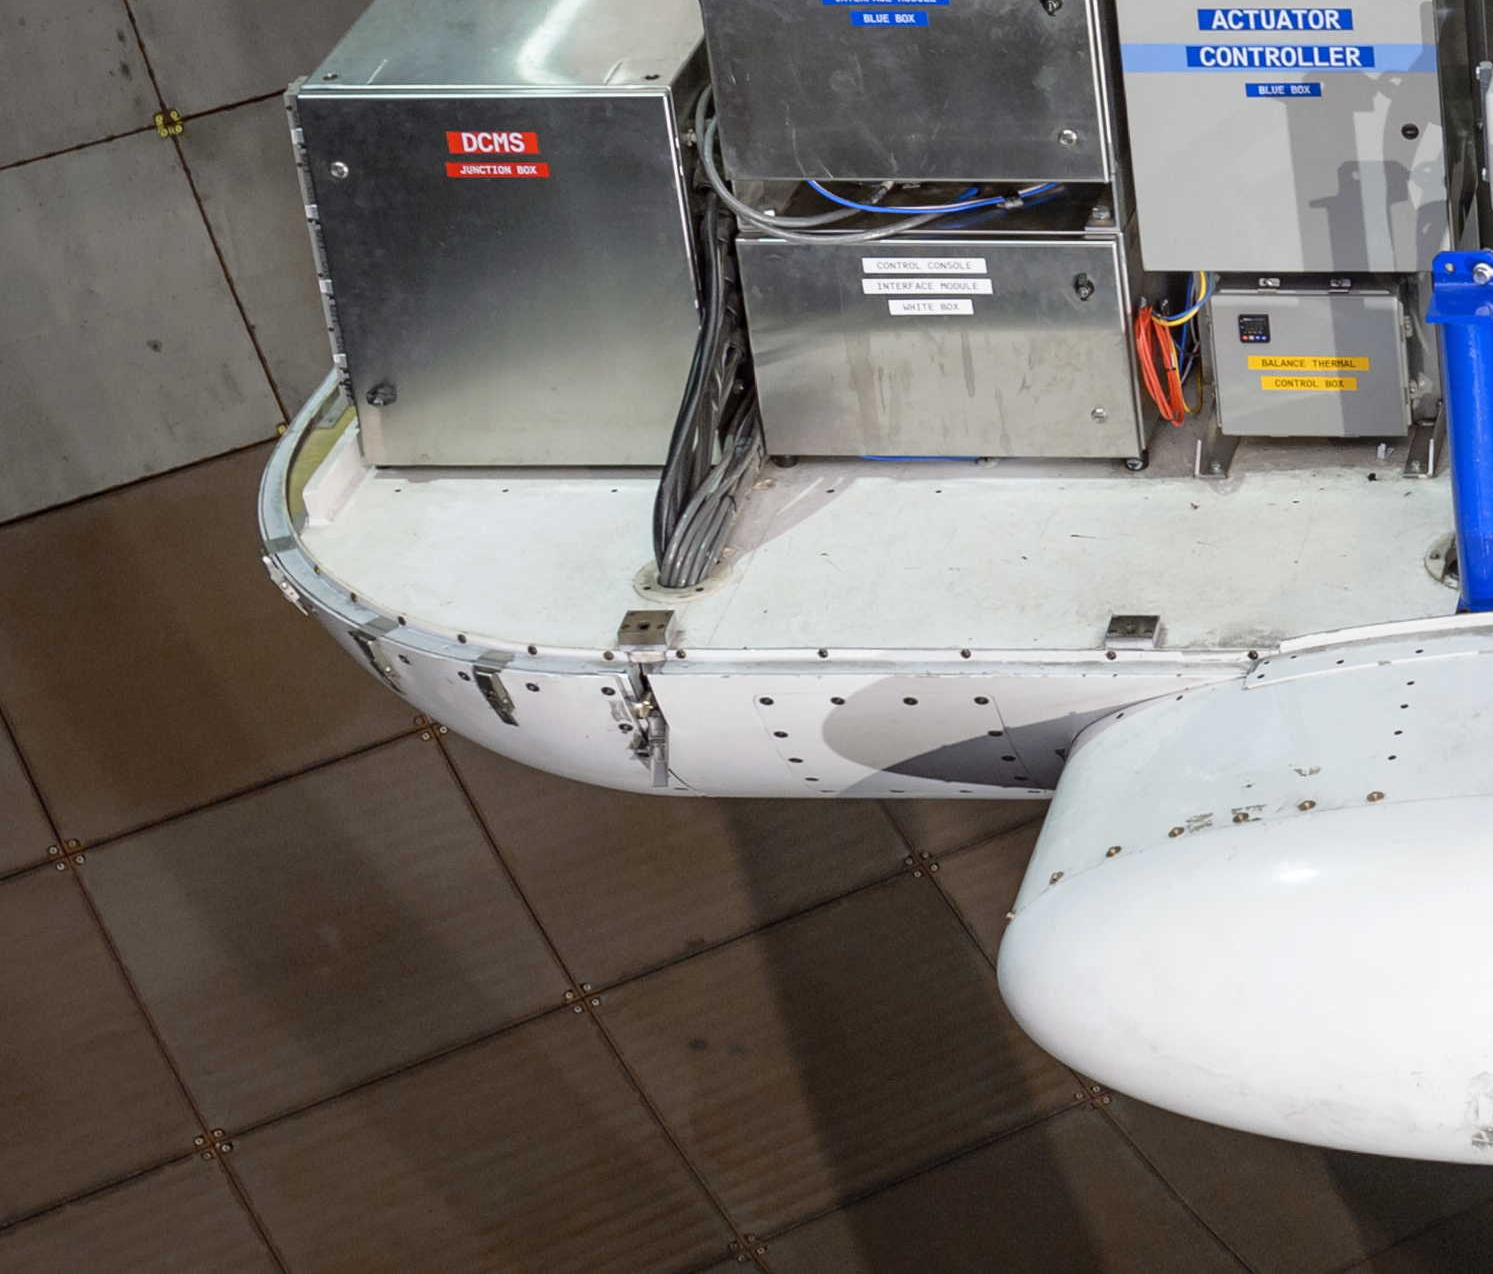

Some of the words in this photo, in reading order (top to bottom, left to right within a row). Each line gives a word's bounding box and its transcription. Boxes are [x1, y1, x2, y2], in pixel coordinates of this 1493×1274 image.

[863, 13, 890, 24] BLUE
[894, 13, 916, 24] BOX
[1211, 9, 1342, 30] ACTUATOR
[1199, 46, 1362, 67] CONTROLLER
[1258, 85, 1285, 95] BLUE
[1291, 85, 1311, 95] BOX
[461, 132, 525, 153] DCMS
[460, 165, 512, 175] JUNCTION
[516, 165, 538, 175] BOX
[876, 261, 921, 270] CONTROL
[927, 261, 972, 270] CONSOLE
[877, 282, 933, 291] INTERFACE
[940, 282, 978, 291] MODULE
[902, 303, 932, 311] WHITE
[940, 303, 959, 311] BOX
[1261, 358, 1305, 368] BALANCE
[1313, 359, 1357, 369] THERMAL
[1274, 379, 1319, 388] CONTROL
[1325, 379, 1345, 388] BOX
